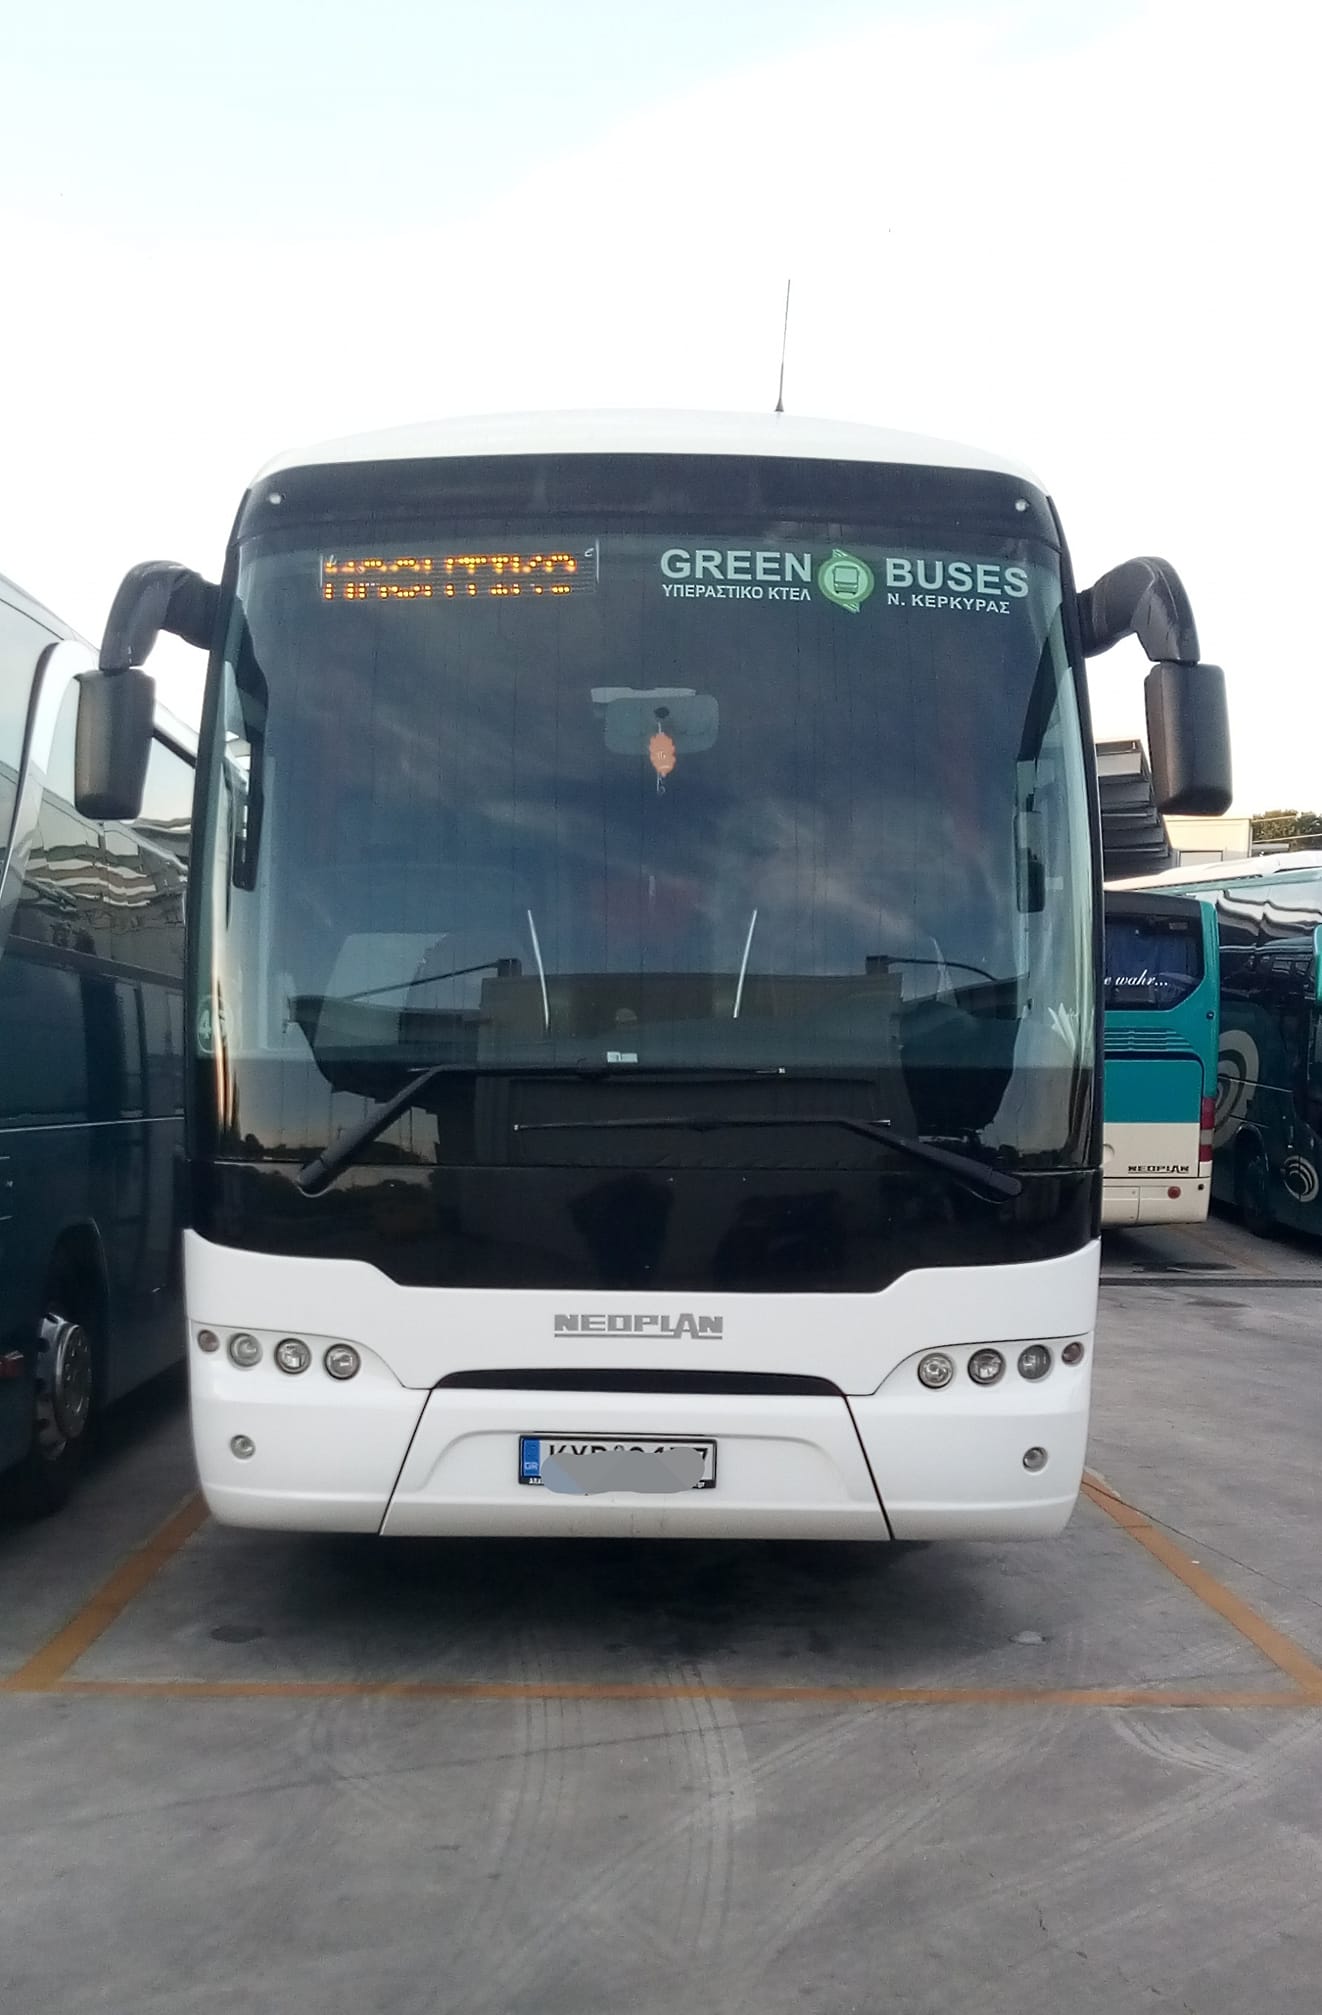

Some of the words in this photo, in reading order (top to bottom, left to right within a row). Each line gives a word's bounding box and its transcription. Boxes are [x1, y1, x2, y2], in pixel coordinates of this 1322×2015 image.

[660, 548, 812, 582] GREEN
[886, 558, 1029, 598] BUSES
[662, 584, 764, 600] ΥΠΕΡΑΣΤΙΚΟ
[768, 586, 812, 601] ΚΤΕΛ
[911, 594, 1011, 615] ΚΕΡΚΥΡΑΣ
[1127, 1164, 1189, 1174] NEOPLAN
[554, 1313, 724, 1340] NEOPLAN
